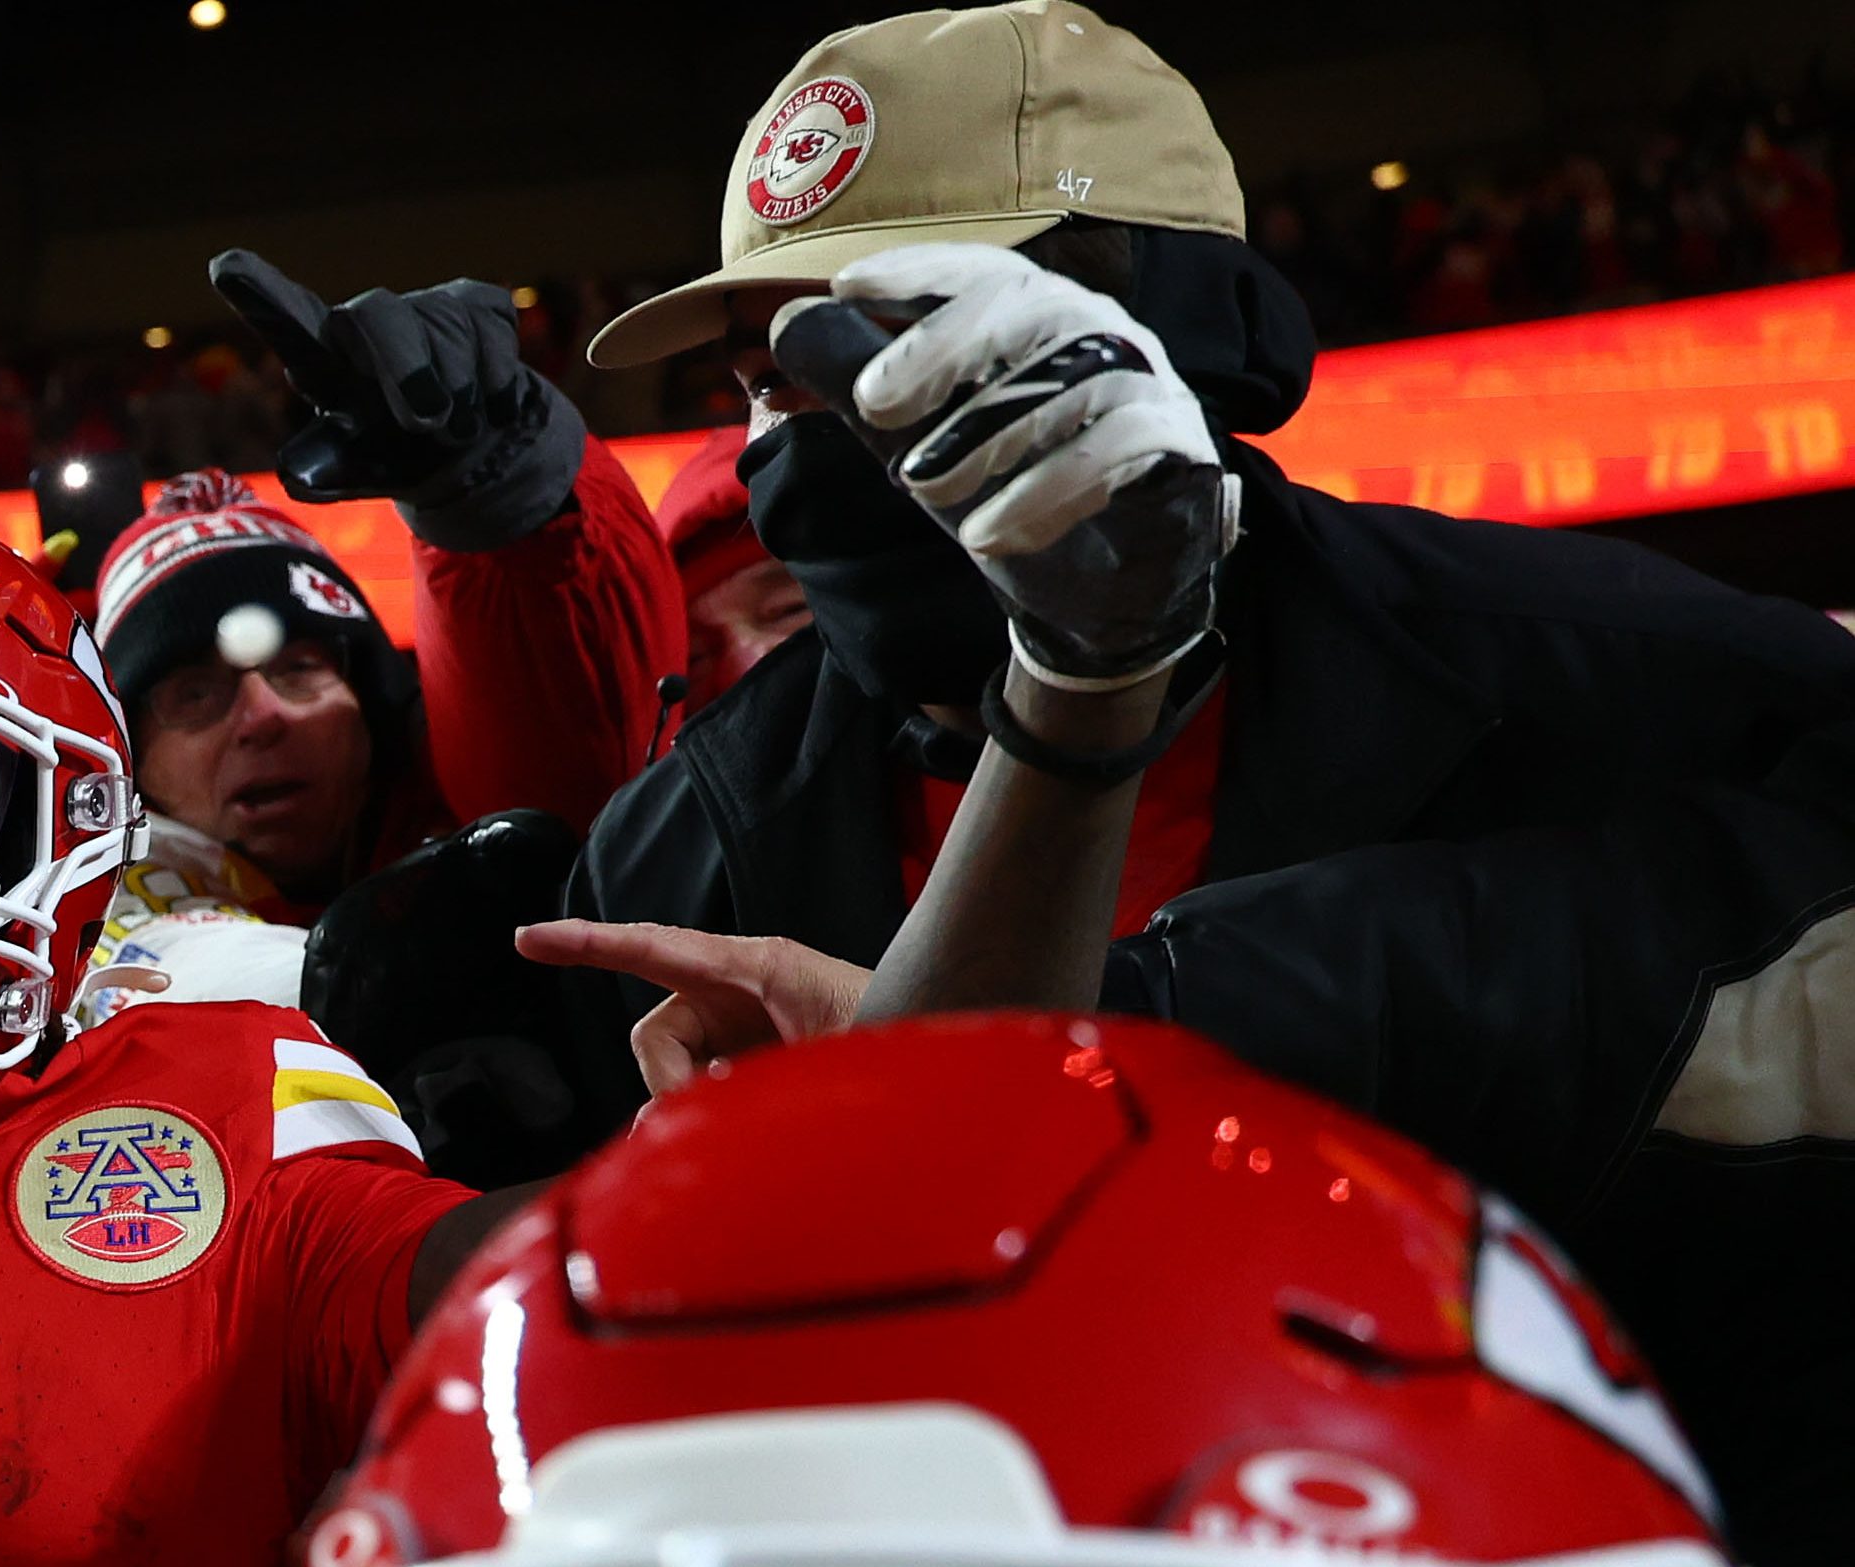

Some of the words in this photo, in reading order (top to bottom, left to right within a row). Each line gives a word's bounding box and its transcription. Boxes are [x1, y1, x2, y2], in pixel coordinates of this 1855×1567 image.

[765, 86, 824, 142] KANSAS
[825, 84, 859, 112] CITY
[762, 183, 828, 217] CHIEFS
[46, 1122, 202, 1220] A
[103, 1222, 152, 1246] LH
